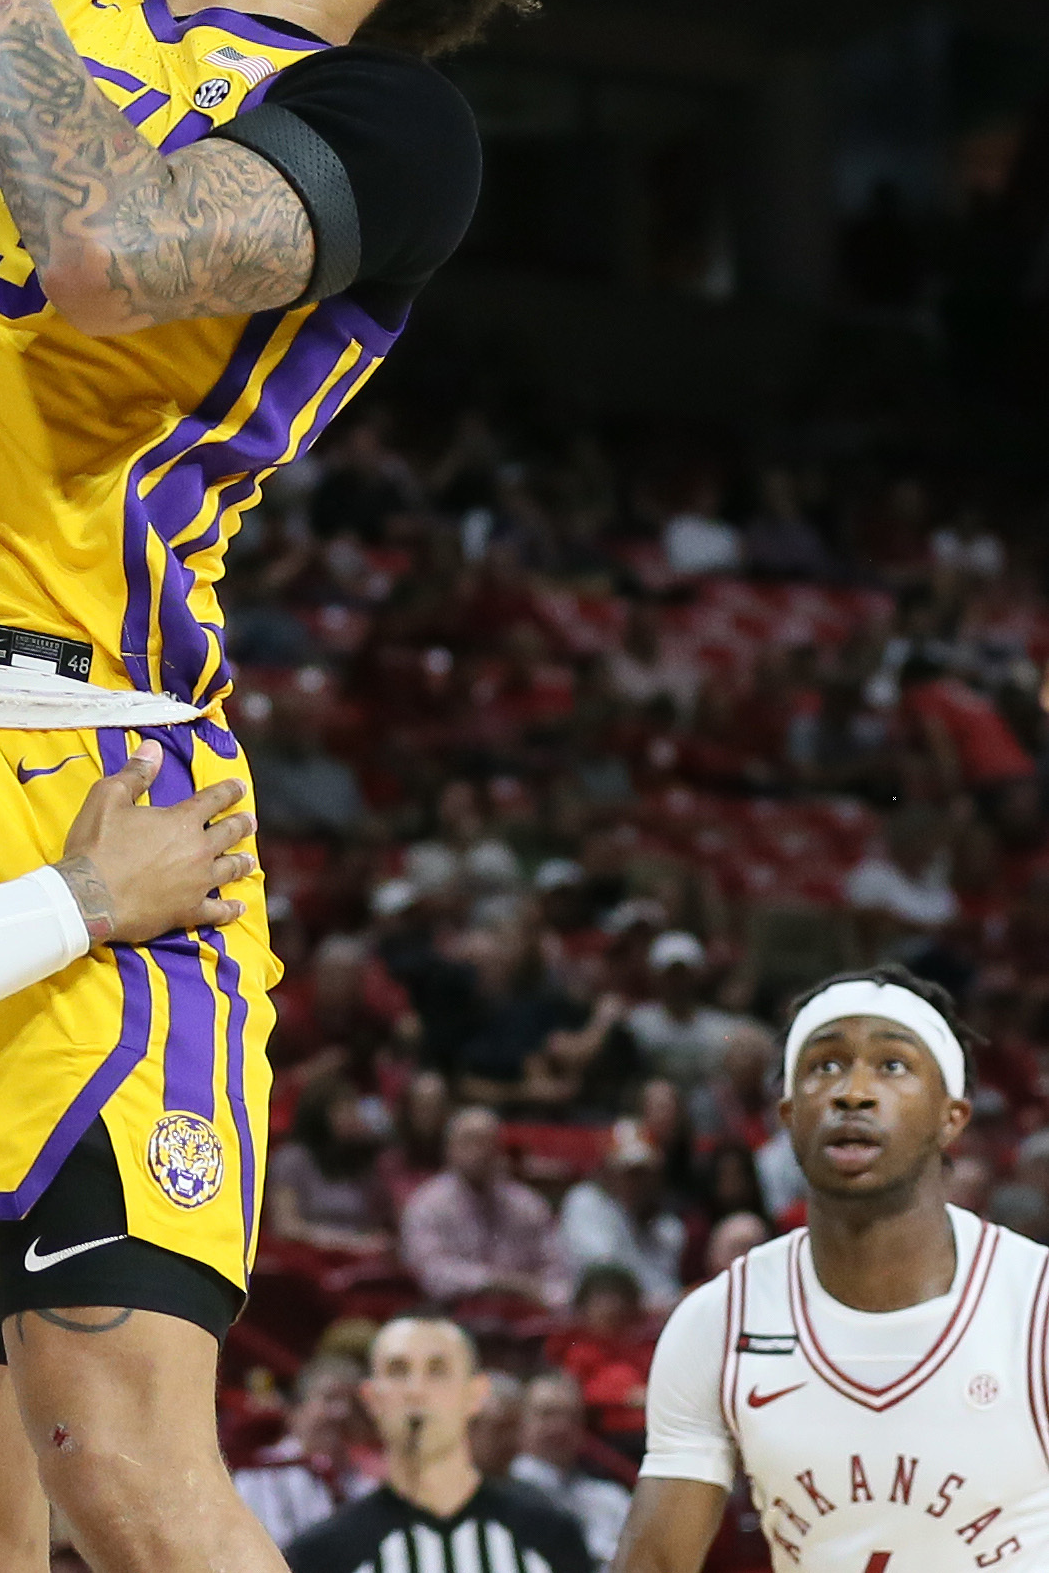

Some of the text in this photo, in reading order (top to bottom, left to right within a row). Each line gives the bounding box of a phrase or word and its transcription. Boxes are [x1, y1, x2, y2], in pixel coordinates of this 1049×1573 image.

[195, 78, 231, 108] SEC
[68, 654, 90, 675] 48
[773, 1454, 1021, 1569] ARKANSAS
